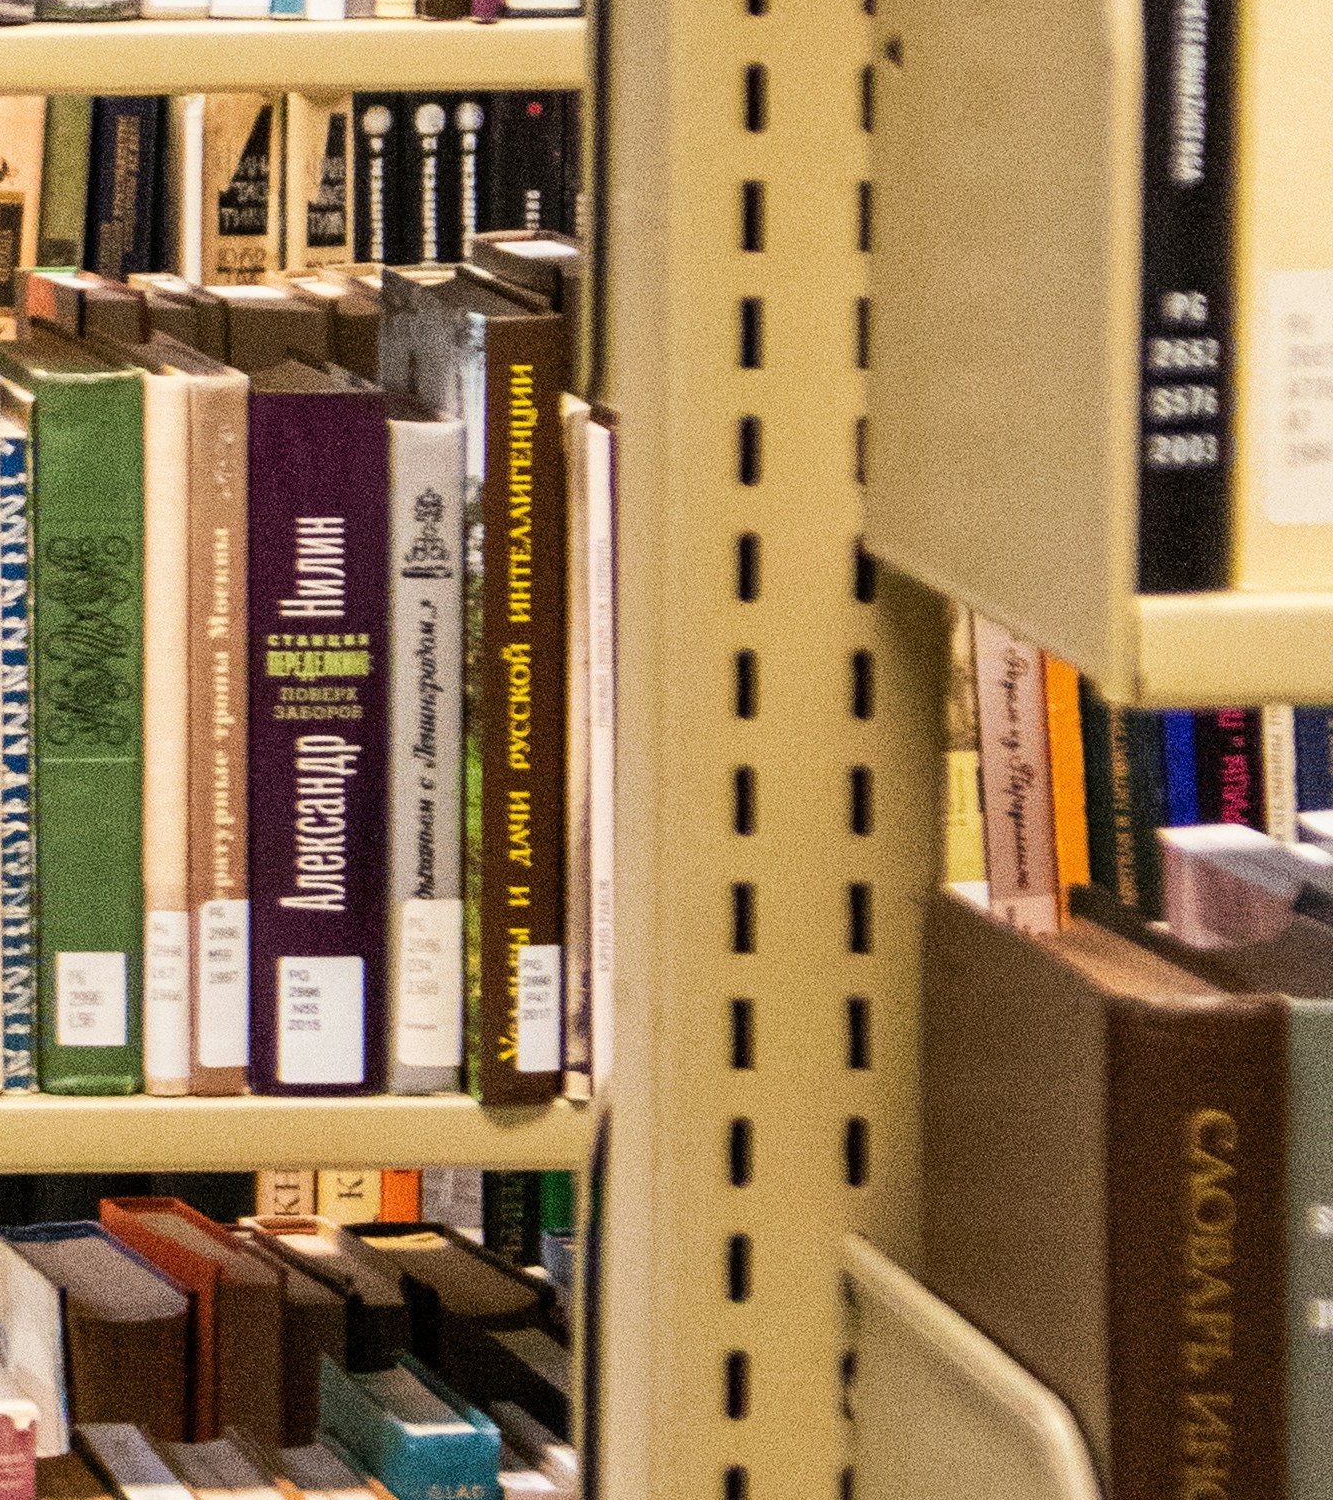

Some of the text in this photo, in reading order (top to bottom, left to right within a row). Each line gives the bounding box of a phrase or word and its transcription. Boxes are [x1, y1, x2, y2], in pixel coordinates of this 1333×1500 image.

[508, 363, 538, 624] ИНТЕЛЛИГЕНЦИИ
[206, 526, 236, 740] тропы Москвы
[278, 686, 359, 701] ПОВЕРХ
[272, 704, 365, 720] ЗАБОРОВ
[276, 516, 364, 913] Александр Нилин
[503, 641, 537, 770] РУССКОЙ
[508, 791, 536, 867] ДАЧИ
[508, 886, 533, 908] И
[1180, 1107, 1236, 1375] СЛОВАРЬ
